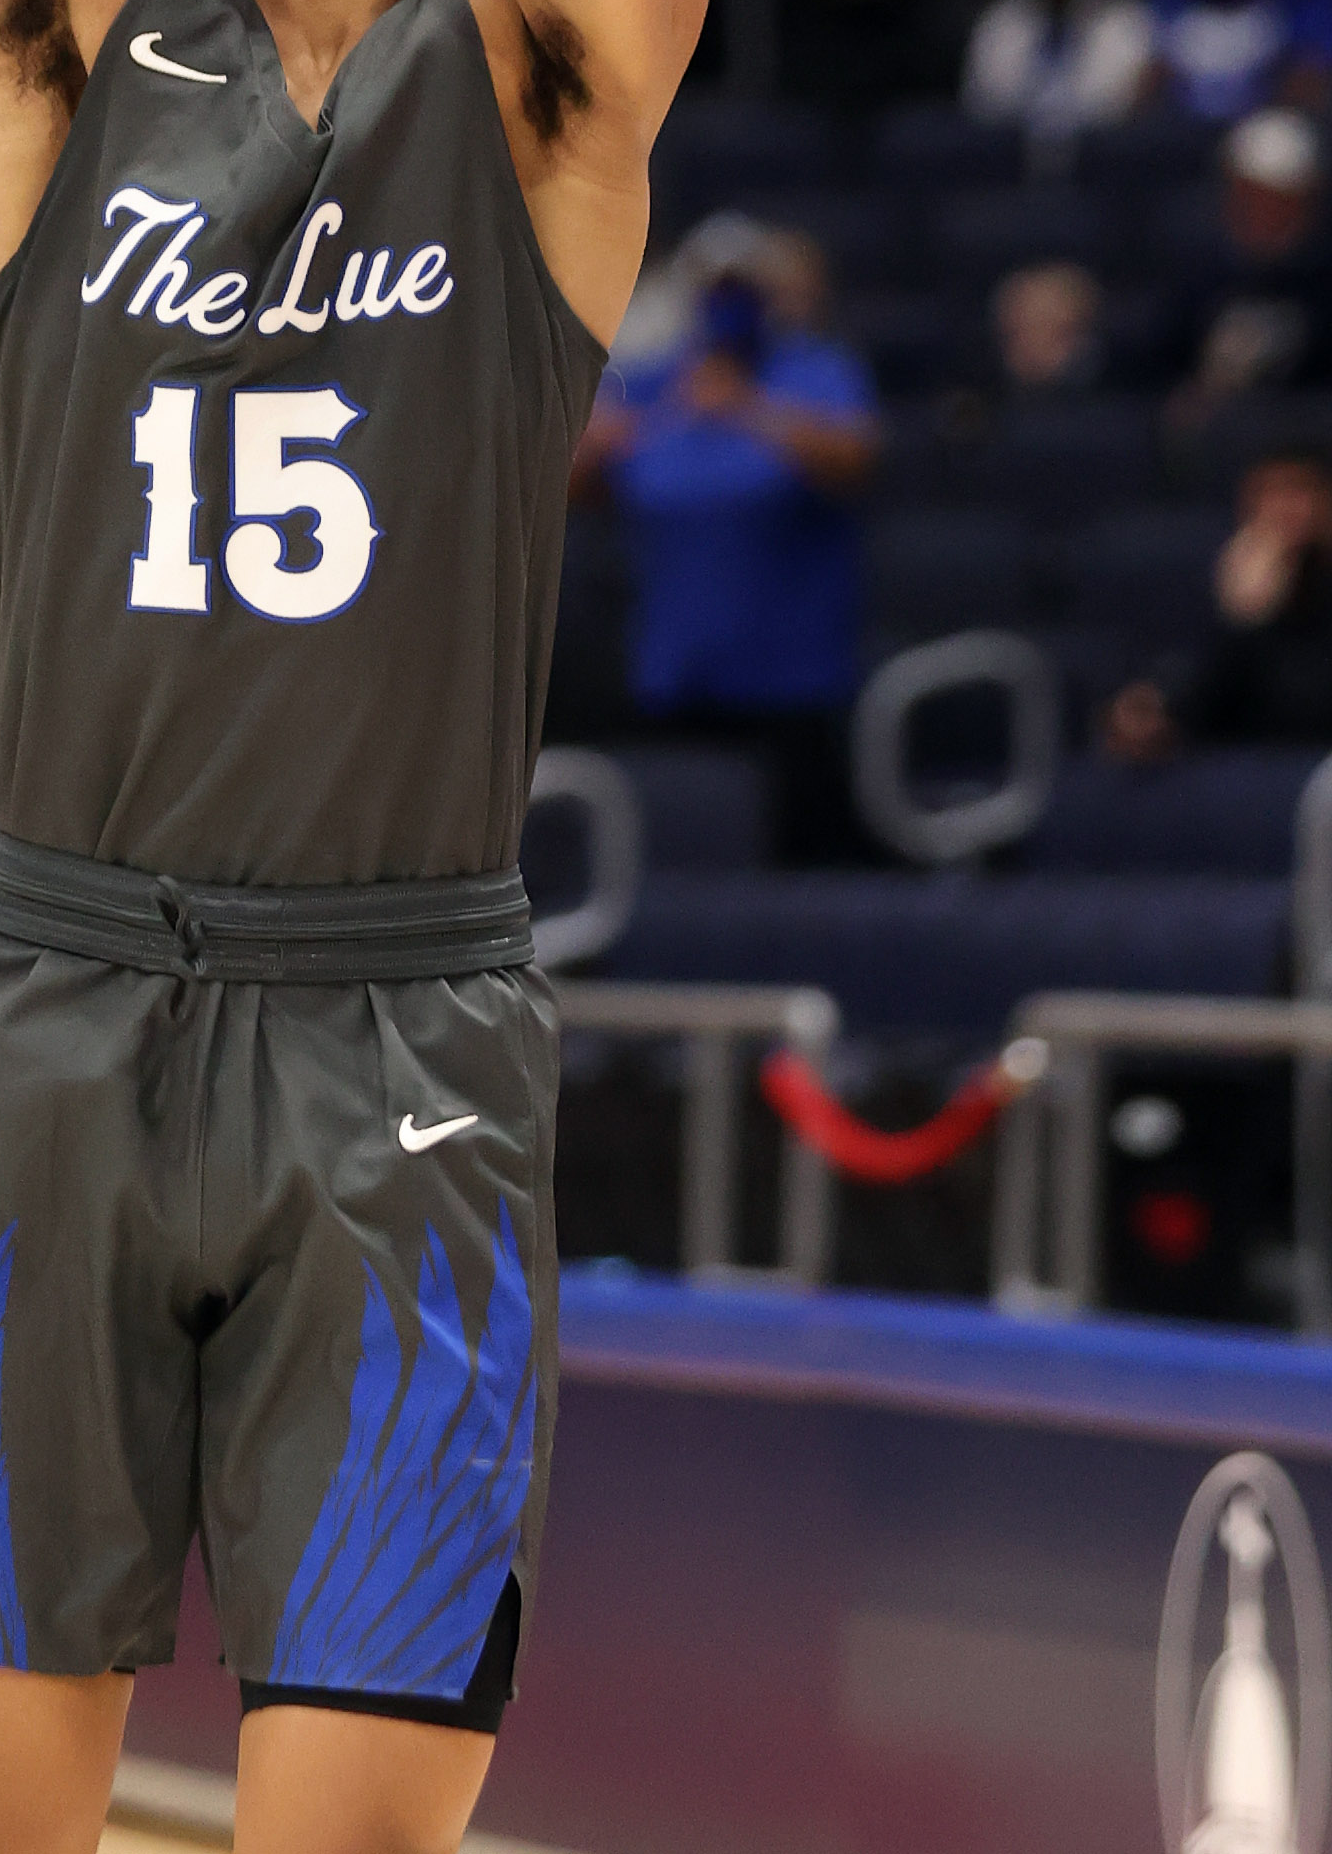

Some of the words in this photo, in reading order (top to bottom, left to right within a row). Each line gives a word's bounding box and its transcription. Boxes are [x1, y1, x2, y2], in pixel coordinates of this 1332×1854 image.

[81, 185, 251, 336] The
[257, 199, 455, 336] Lue
[126, 381, 385, 625] 15
